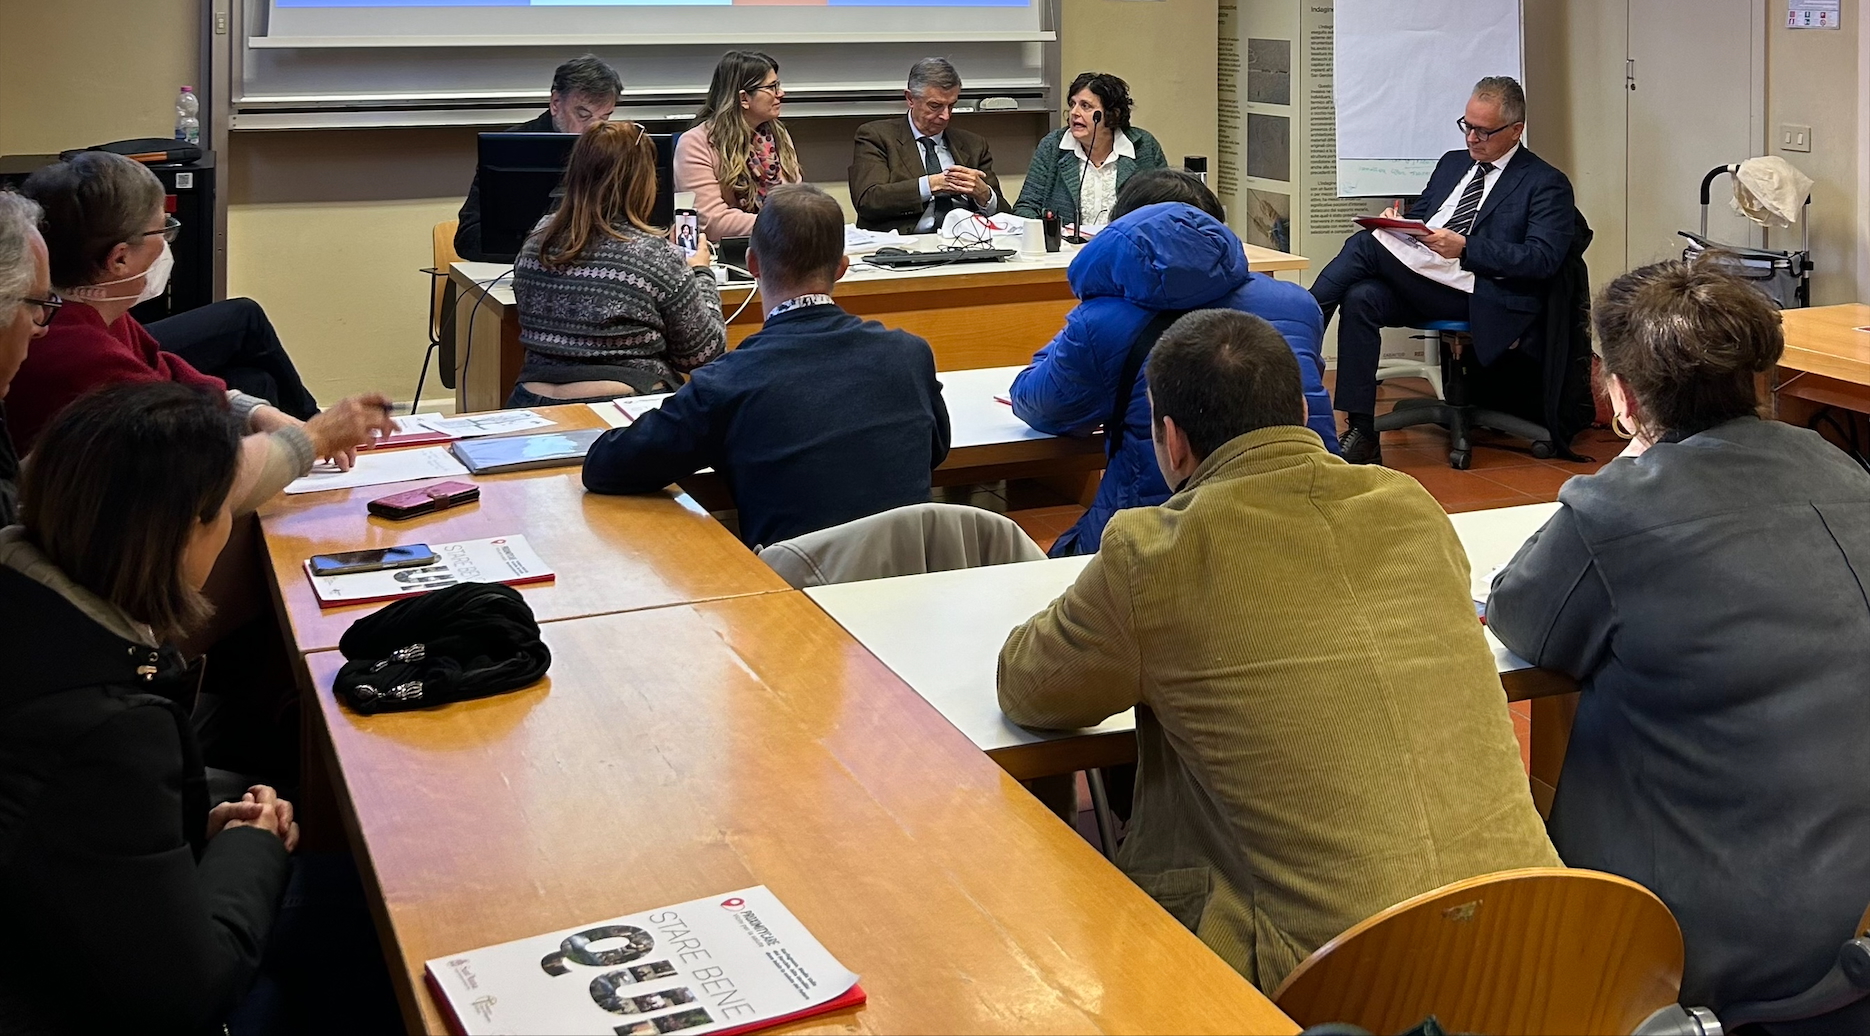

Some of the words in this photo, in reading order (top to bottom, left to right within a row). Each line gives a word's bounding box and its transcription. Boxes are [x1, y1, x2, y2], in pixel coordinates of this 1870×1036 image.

[1311, 6, 1334, 14] Indagin
[444, 544, 474, 568] STARE
[741, 910, 781, 946] PROXIMITYCARE
[541, 925, 714, 1036] QUI
[649, 911, 712, 964] STARE
[692, 966, 756, 1020] BENE
